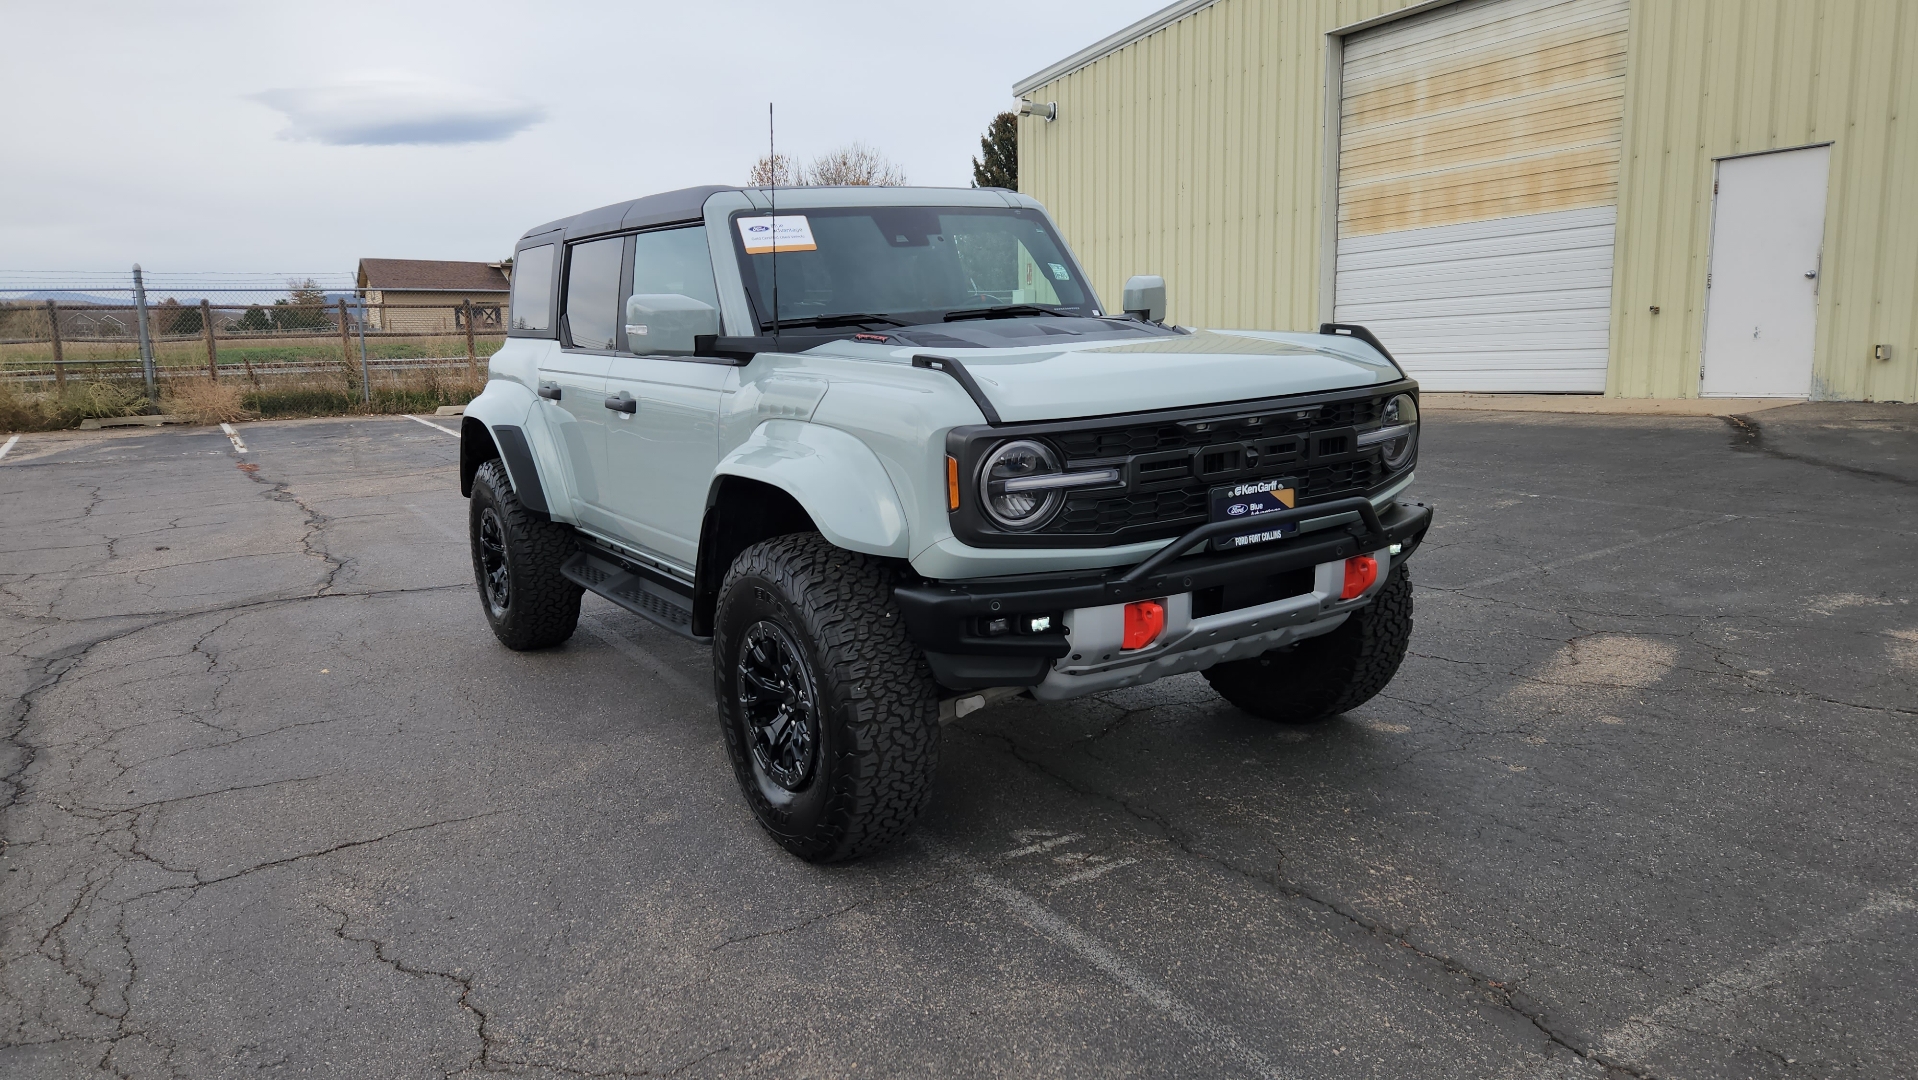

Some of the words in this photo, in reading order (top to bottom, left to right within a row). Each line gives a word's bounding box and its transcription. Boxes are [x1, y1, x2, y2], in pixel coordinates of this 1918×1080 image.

[1242, 484, 1258, 495] Ken
[1258, 480, 1278, 493] Garff
[1250, 503, 1263, 511] Blue
[1249, 533, 1261, 544] FORT
